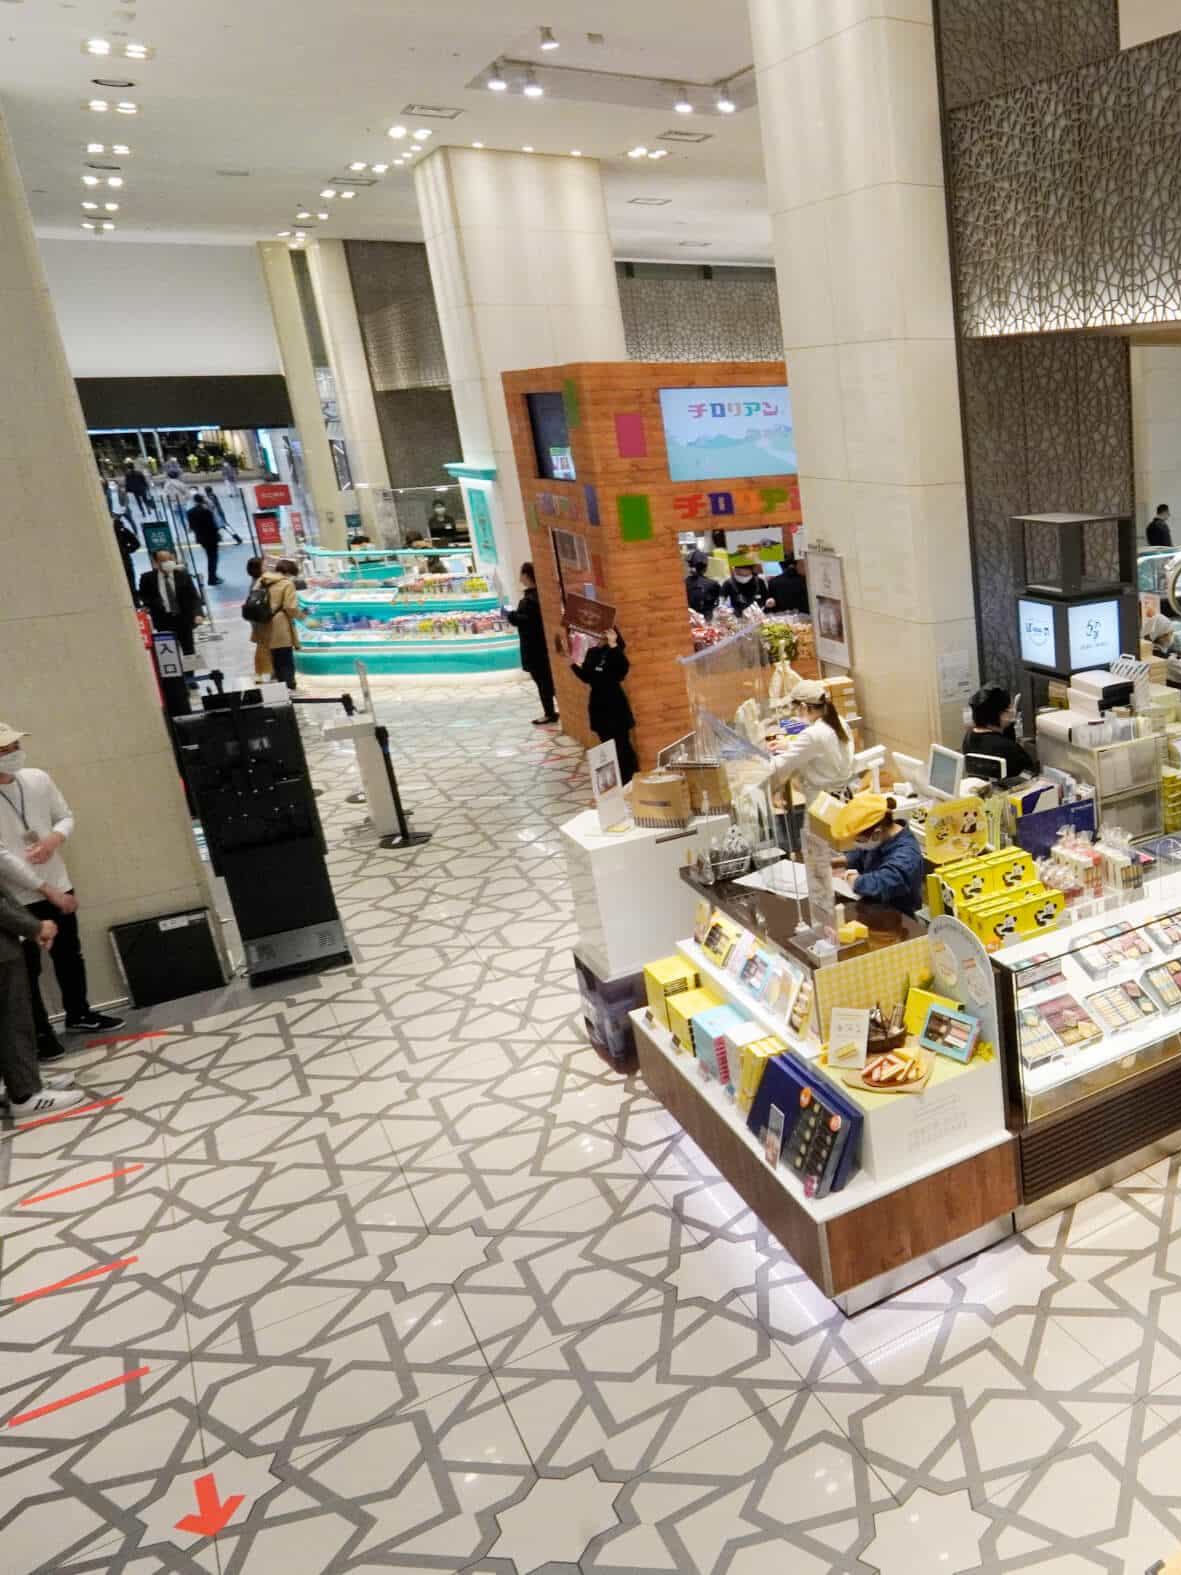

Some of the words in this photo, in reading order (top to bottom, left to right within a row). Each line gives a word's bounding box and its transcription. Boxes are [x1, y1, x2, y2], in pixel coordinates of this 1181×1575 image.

[687, 401, 778, 419] チロリアン
[160, 643, 177, 674] 入口
